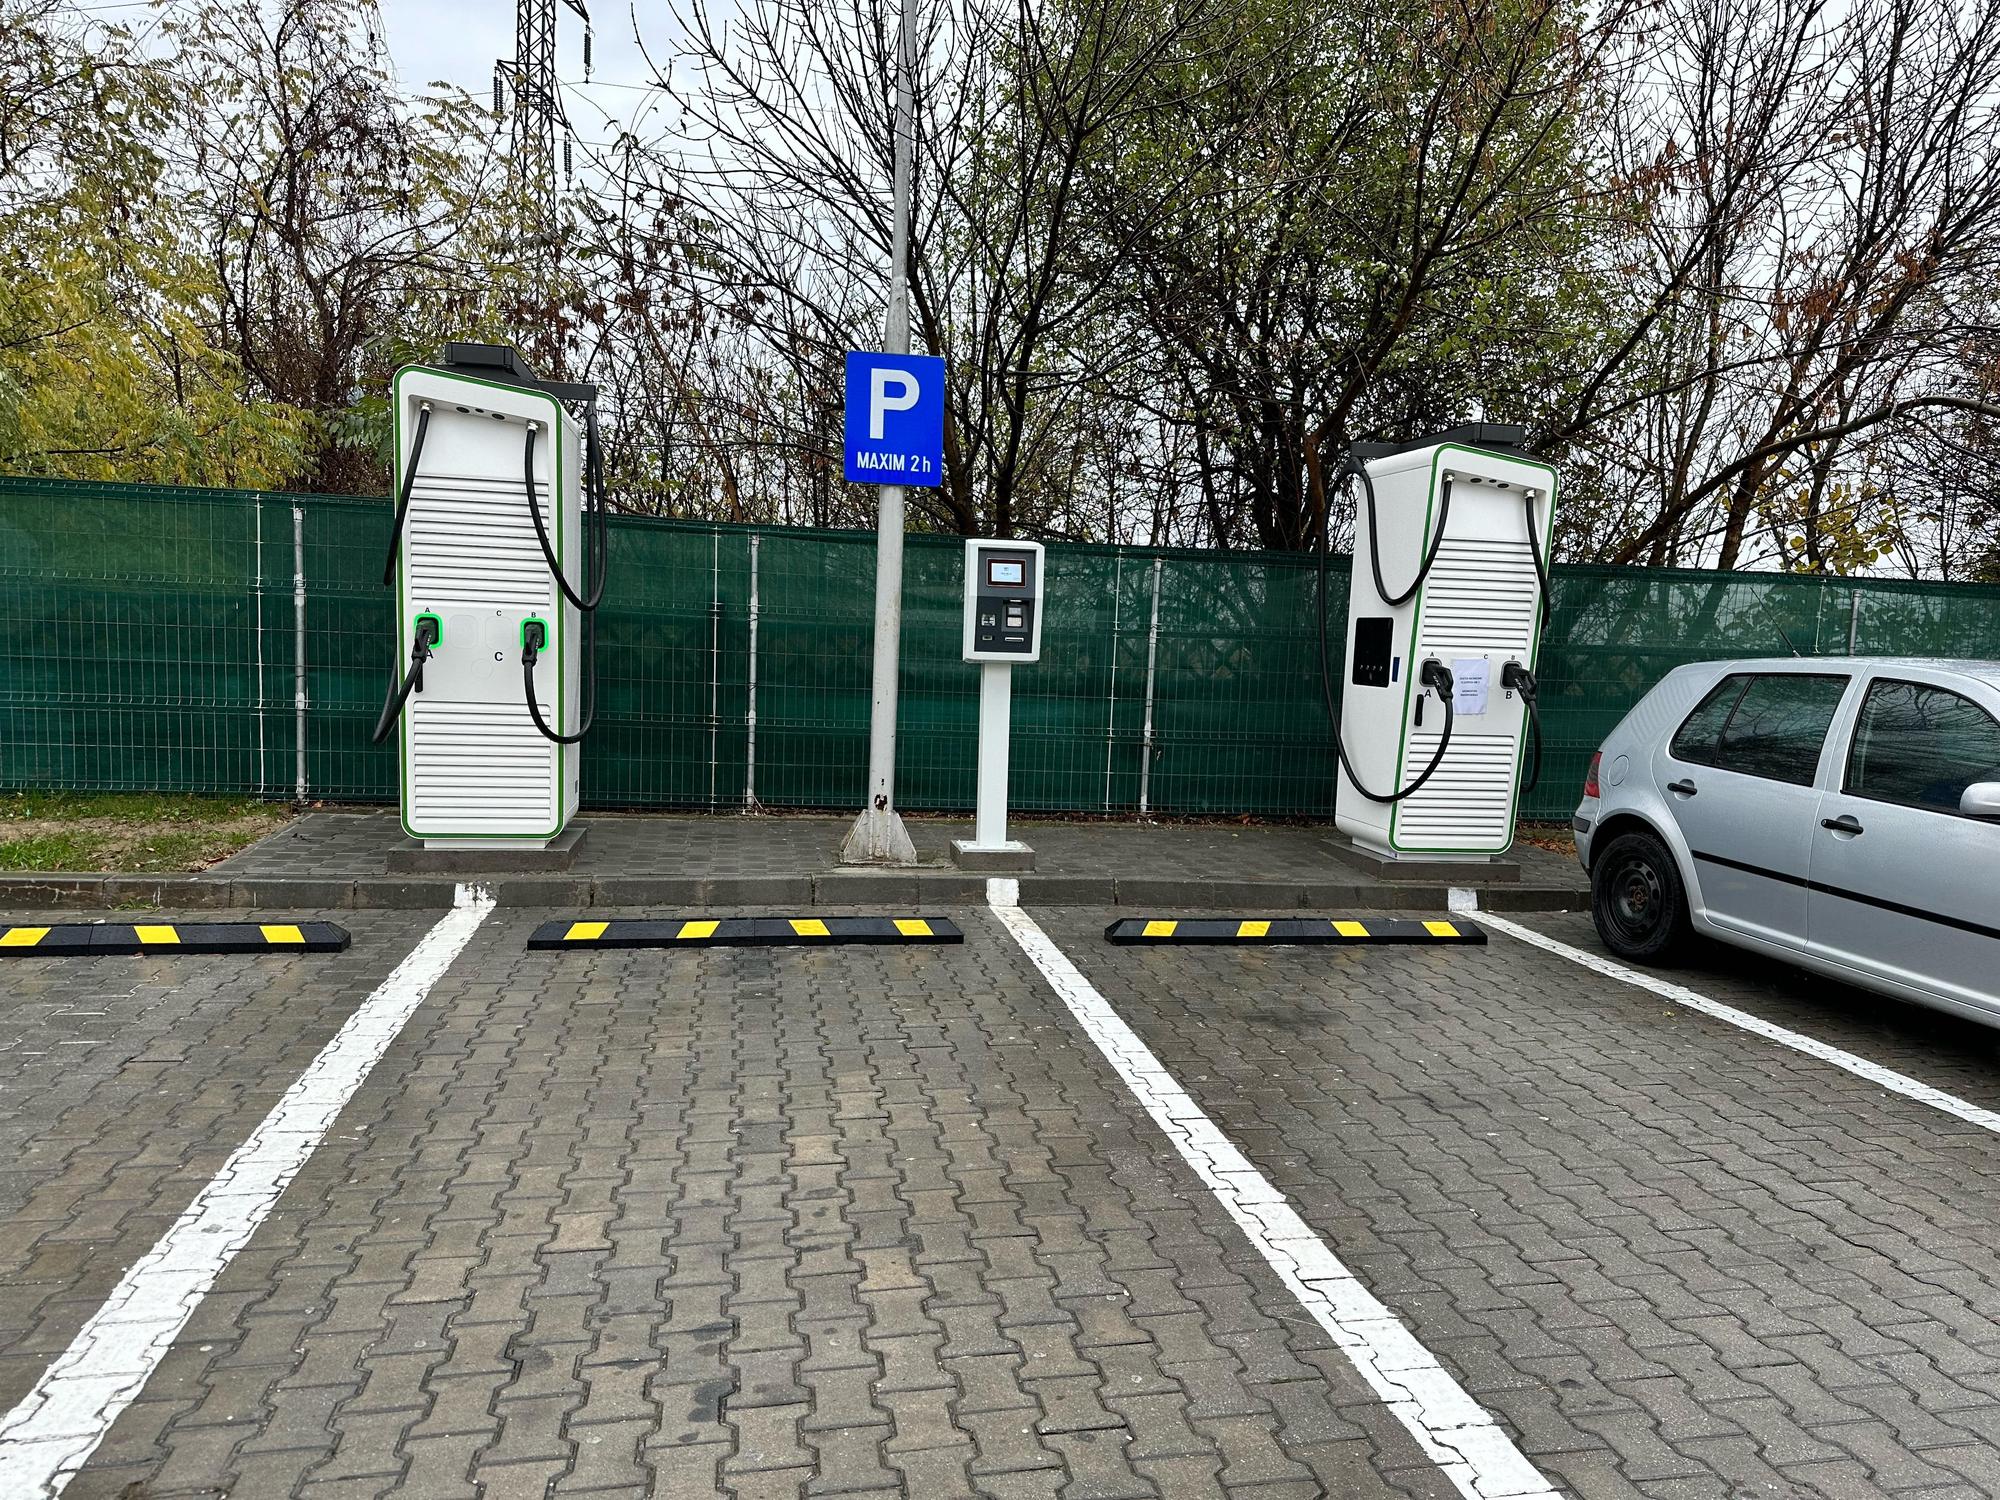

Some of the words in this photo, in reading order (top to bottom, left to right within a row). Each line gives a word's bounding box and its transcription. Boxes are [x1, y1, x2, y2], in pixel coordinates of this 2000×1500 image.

[870, 368, 919, 439] P
[857, 451, 905, 471] MAXIM
[494, 651, 503, 662] C
[1424, 689, 1431, 697] A
[1506, 691, 1512, 699] B
